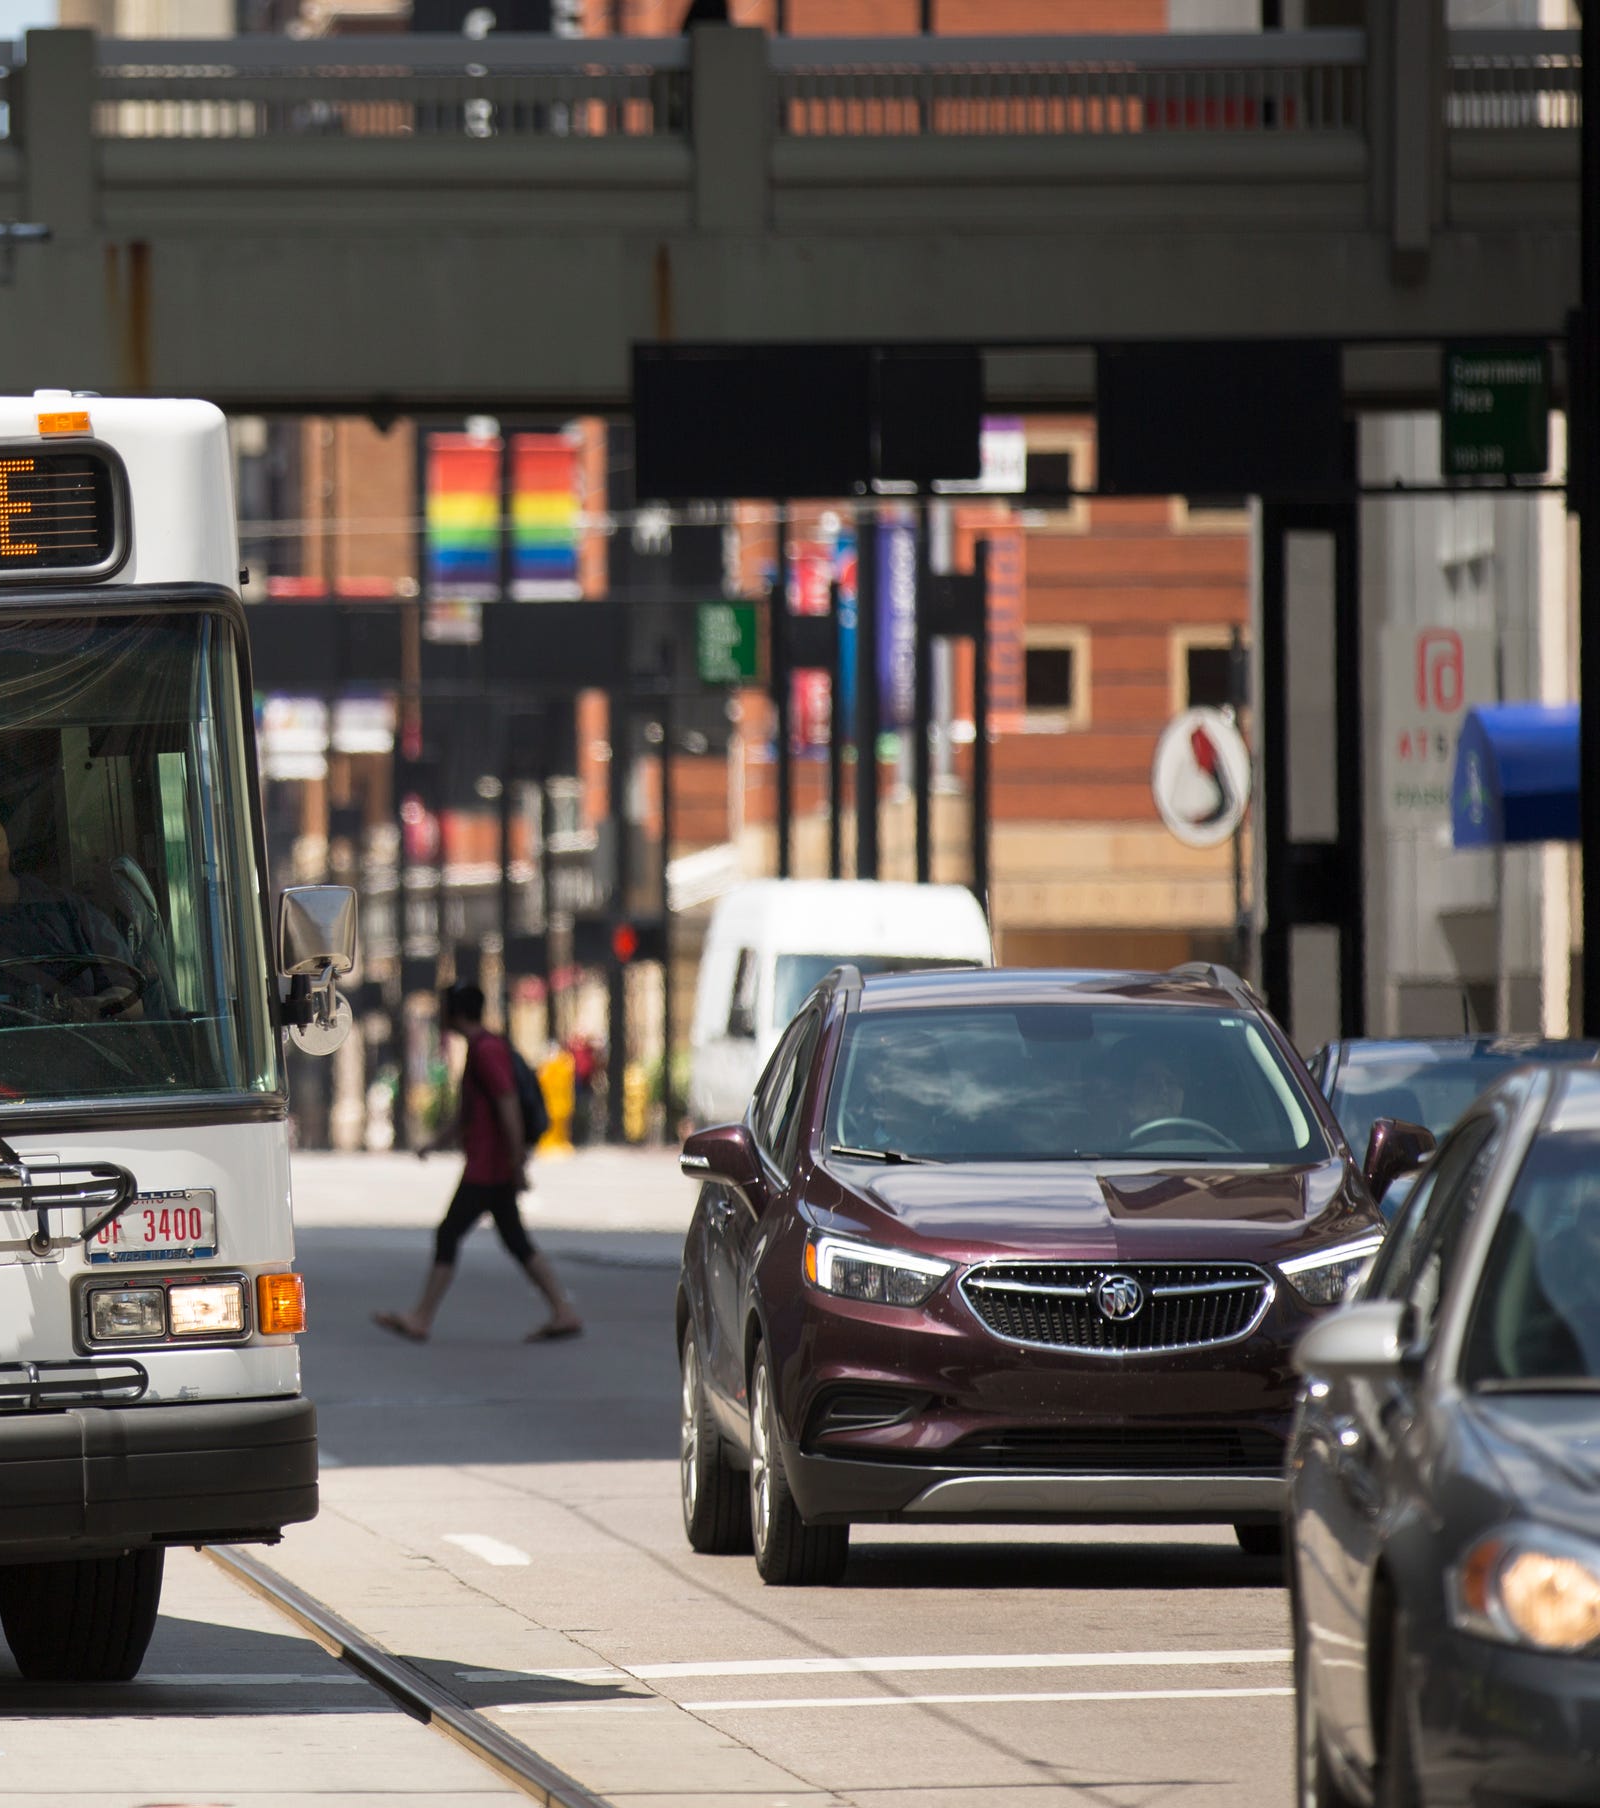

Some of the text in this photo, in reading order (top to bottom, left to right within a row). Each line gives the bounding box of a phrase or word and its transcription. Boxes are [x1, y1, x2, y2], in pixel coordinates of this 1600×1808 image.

[1453, 356, 1542, 384] Government
[1452, 385, 1493, 412] Place
[142, 1207, 202, 1243] 3400
